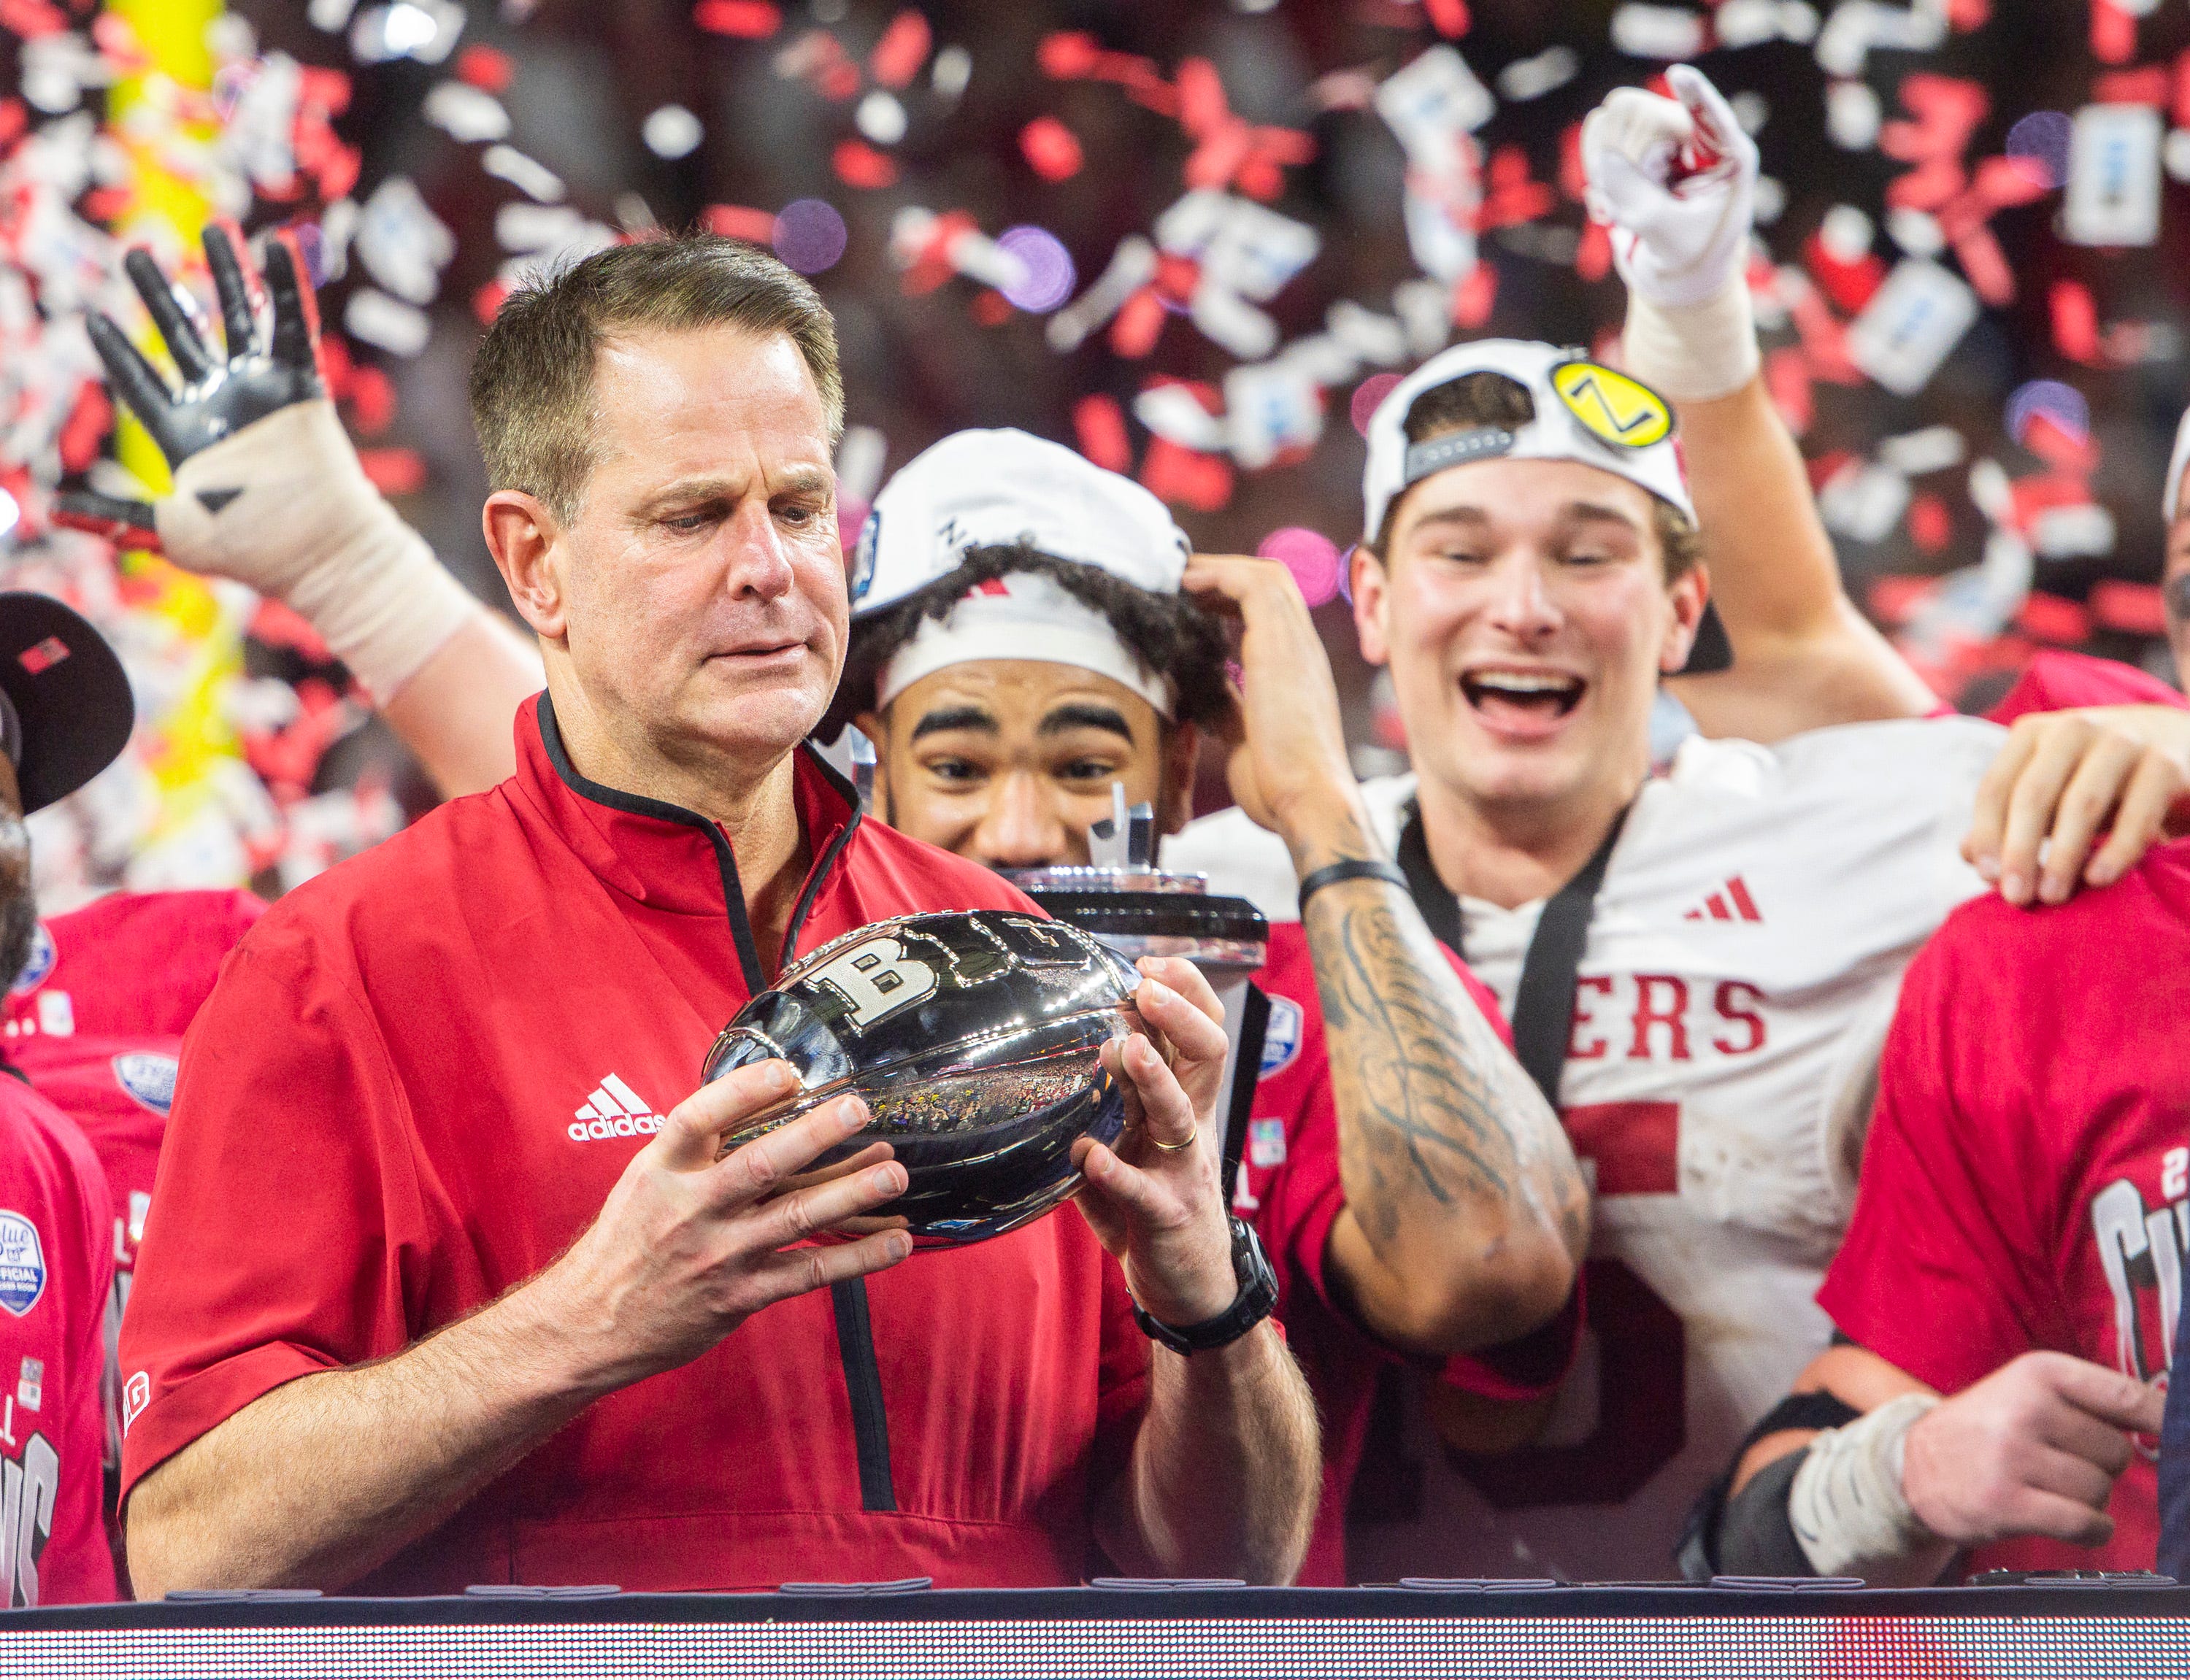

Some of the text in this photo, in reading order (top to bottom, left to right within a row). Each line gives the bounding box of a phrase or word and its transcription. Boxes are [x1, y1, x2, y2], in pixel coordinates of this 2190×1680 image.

[568, 1113, 667, 1142] adidas
[0, 1222, 28, 1244] lue
[0, 1266, 39, 1283] FICIAL
[123, 1370, 151, 1439] G
